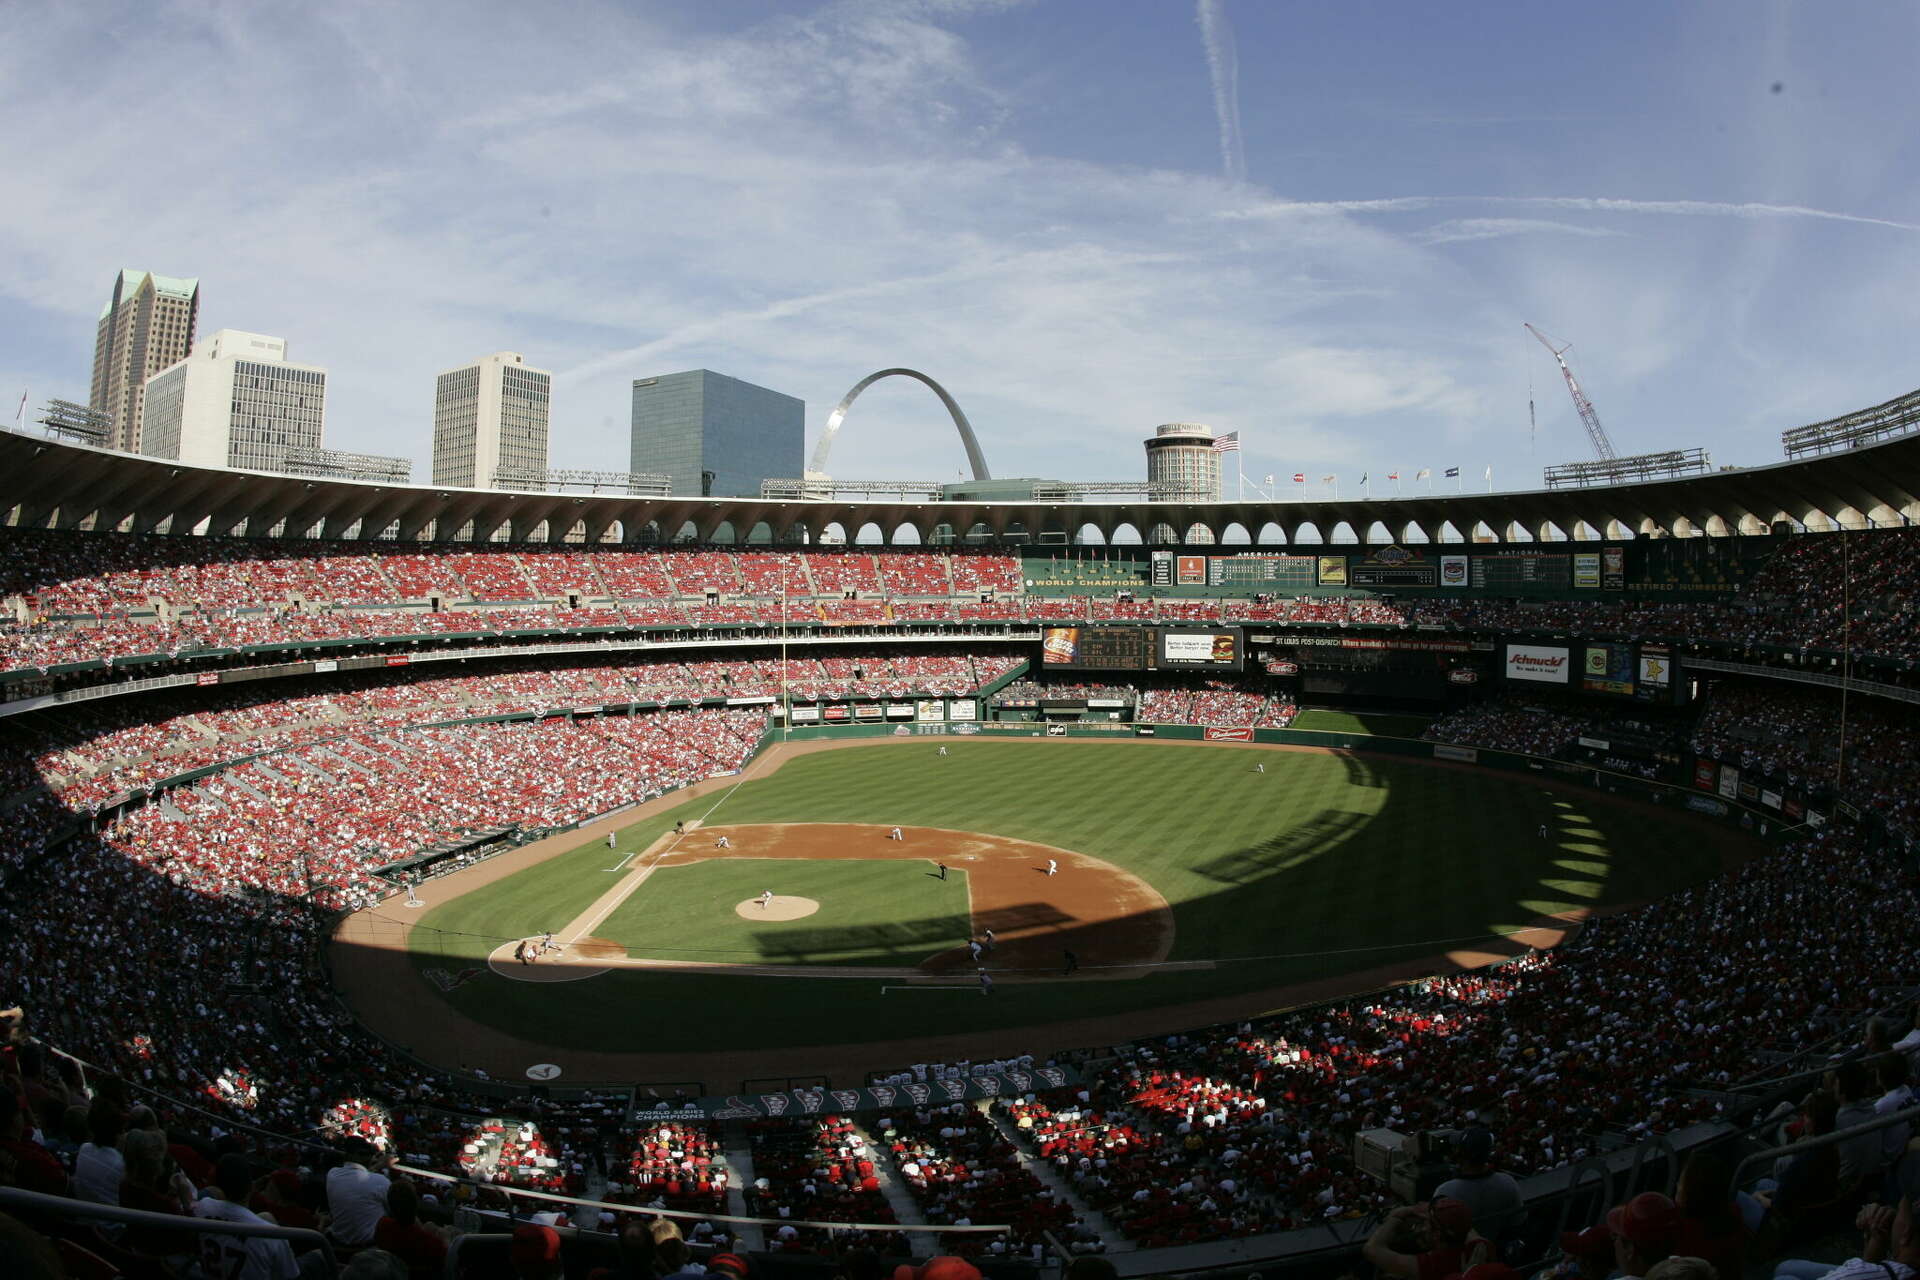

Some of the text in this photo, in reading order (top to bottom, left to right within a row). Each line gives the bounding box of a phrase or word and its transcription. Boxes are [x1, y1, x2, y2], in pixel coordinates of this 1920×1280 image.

[1628, 583, 1673, 591] RETIRED
[1283, 637, 1299, 645] LOUIS
[1301, 638, 1340, 646] POST-DISPATCH
[1509, 654, 1566, 666] Schnucks
